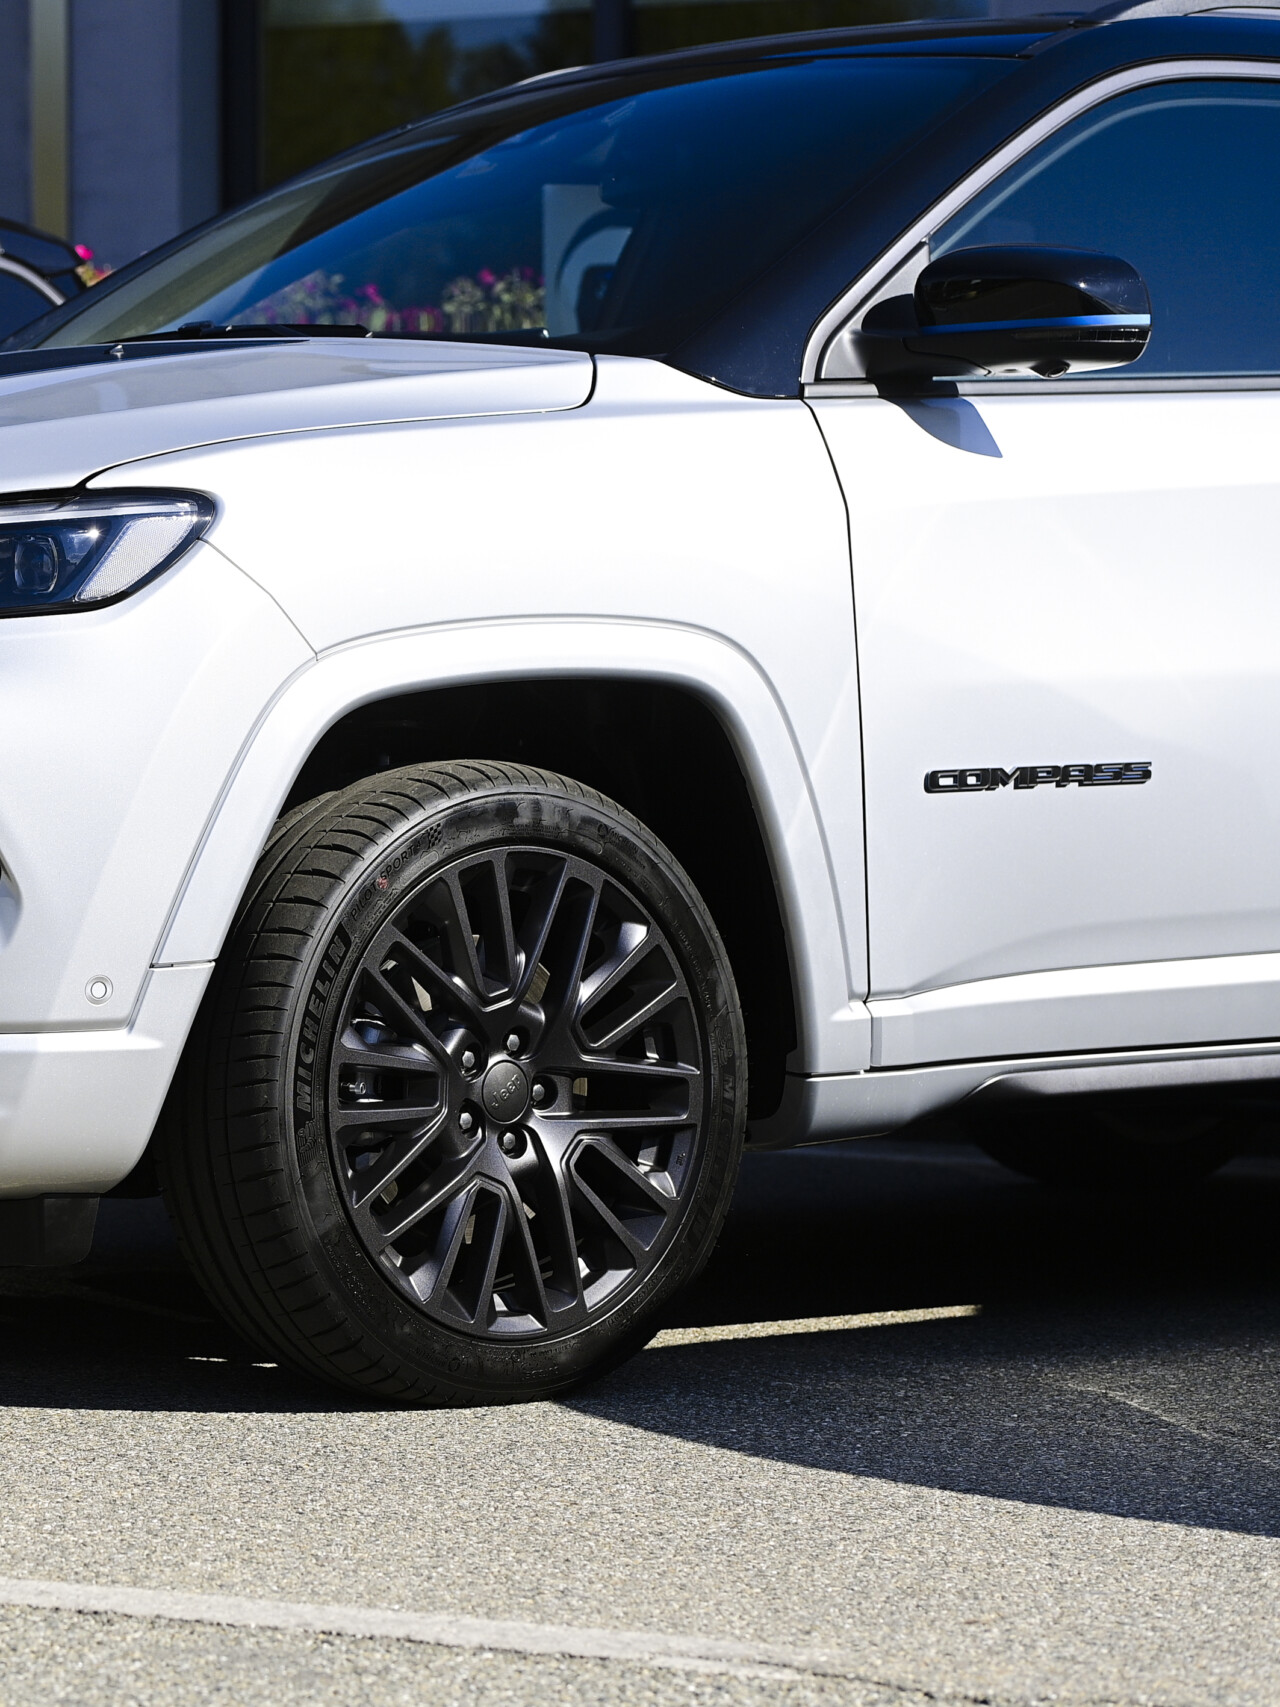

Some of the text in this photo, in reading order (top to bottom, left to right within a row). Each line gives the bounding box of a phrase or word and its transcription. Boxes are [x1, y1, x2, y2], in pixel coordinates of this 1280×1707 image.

[923, 761, 1152, 794] COMPASS
[350, 880, 377, 921] PILOT
[380, 846, 415, 879] SPORT
[296, 935, 347, 1113] MICHELIN
